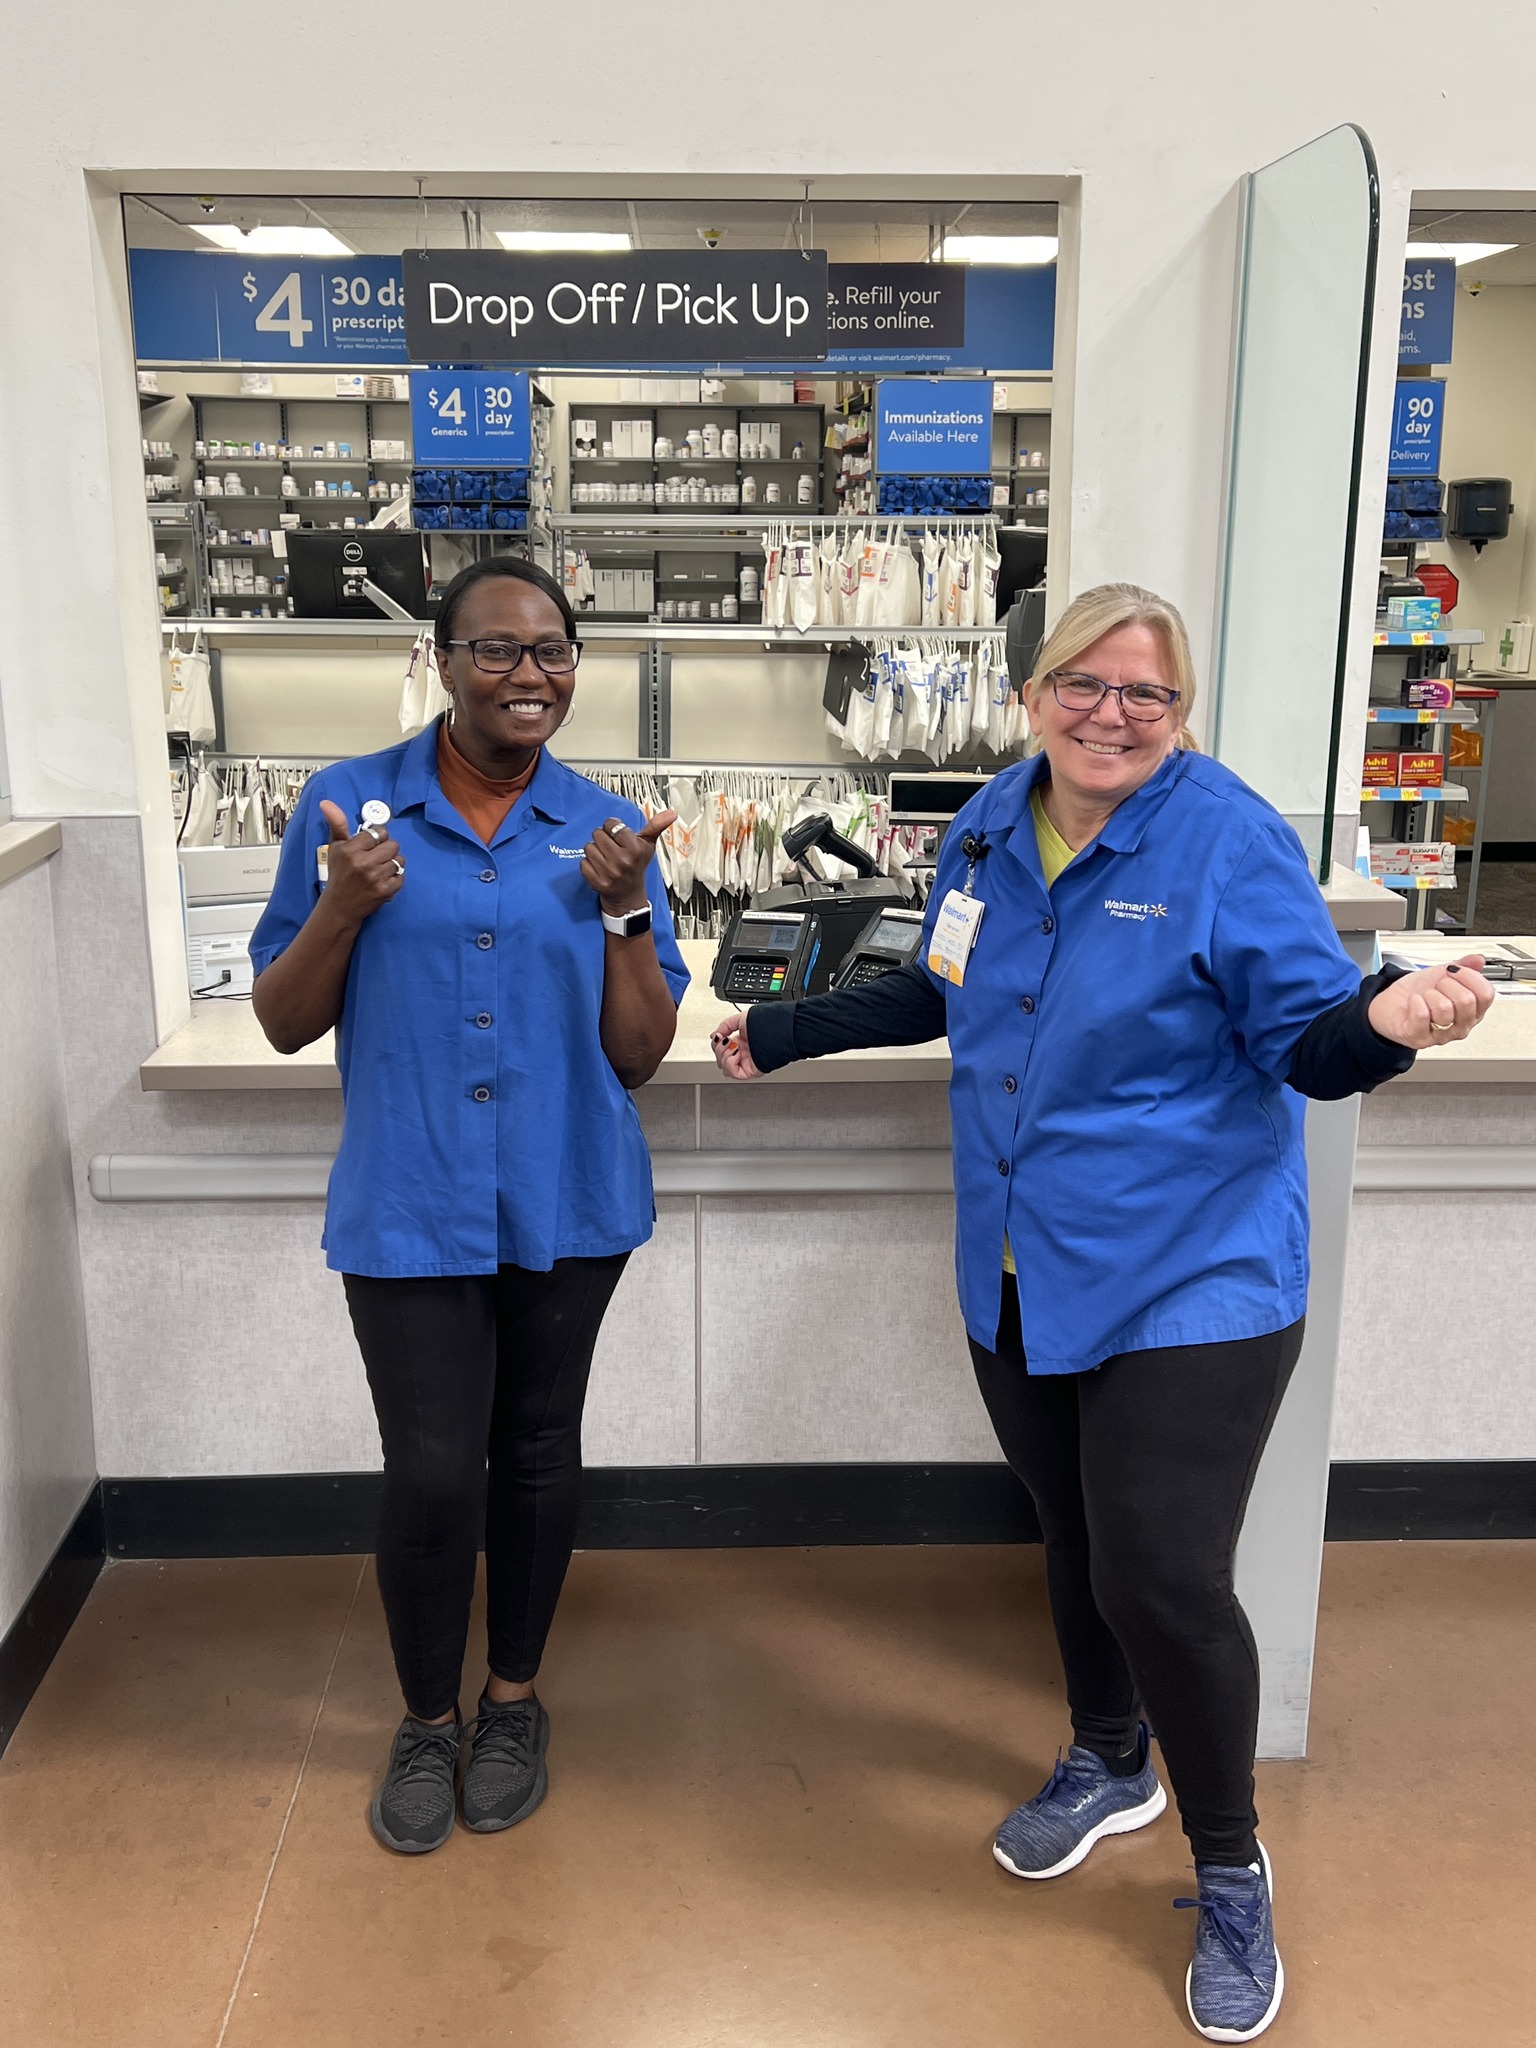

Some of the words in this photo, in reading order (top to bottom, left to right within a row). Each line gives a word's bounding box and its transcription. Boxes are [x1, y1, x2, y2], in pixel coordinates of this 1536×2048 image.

[331, 276, 371, 306] 30
[846, 286, 893, 304] Refill
[899, 289, 942, 309] your
[242, 272, 313, 348] $4
[428, 282, 534, 337] Drop
[547, 282, 627, 324] Off
[657, 283, 739, 324] Pick
[752, 282, 810, 337] Up
[332, 314, 405, 333] prescript
[874, 311, 935, 329] online.
[428, 387, 467, 425] $4
[484, 387, 512, 408] 30
[1408, 397, 1434, 418] 90
[485, 410, 513, 429] day
[884, 410, 984, 425] Immunizations
[431, 427, 468, 437] Generics
[888, 430, 944, 443] Available
[947, 430, 979, 443] Here
[1405, 419, 1432, 437] day
[1391, 450, 1431, 462] Delivery
[1365, 758, 1388, 766] Advil
[1411, 760, 1435, 768] Advil
[1104, 899, 1150, 914] Walmart
[1109, 909, 1147, 921] Pharmacy
